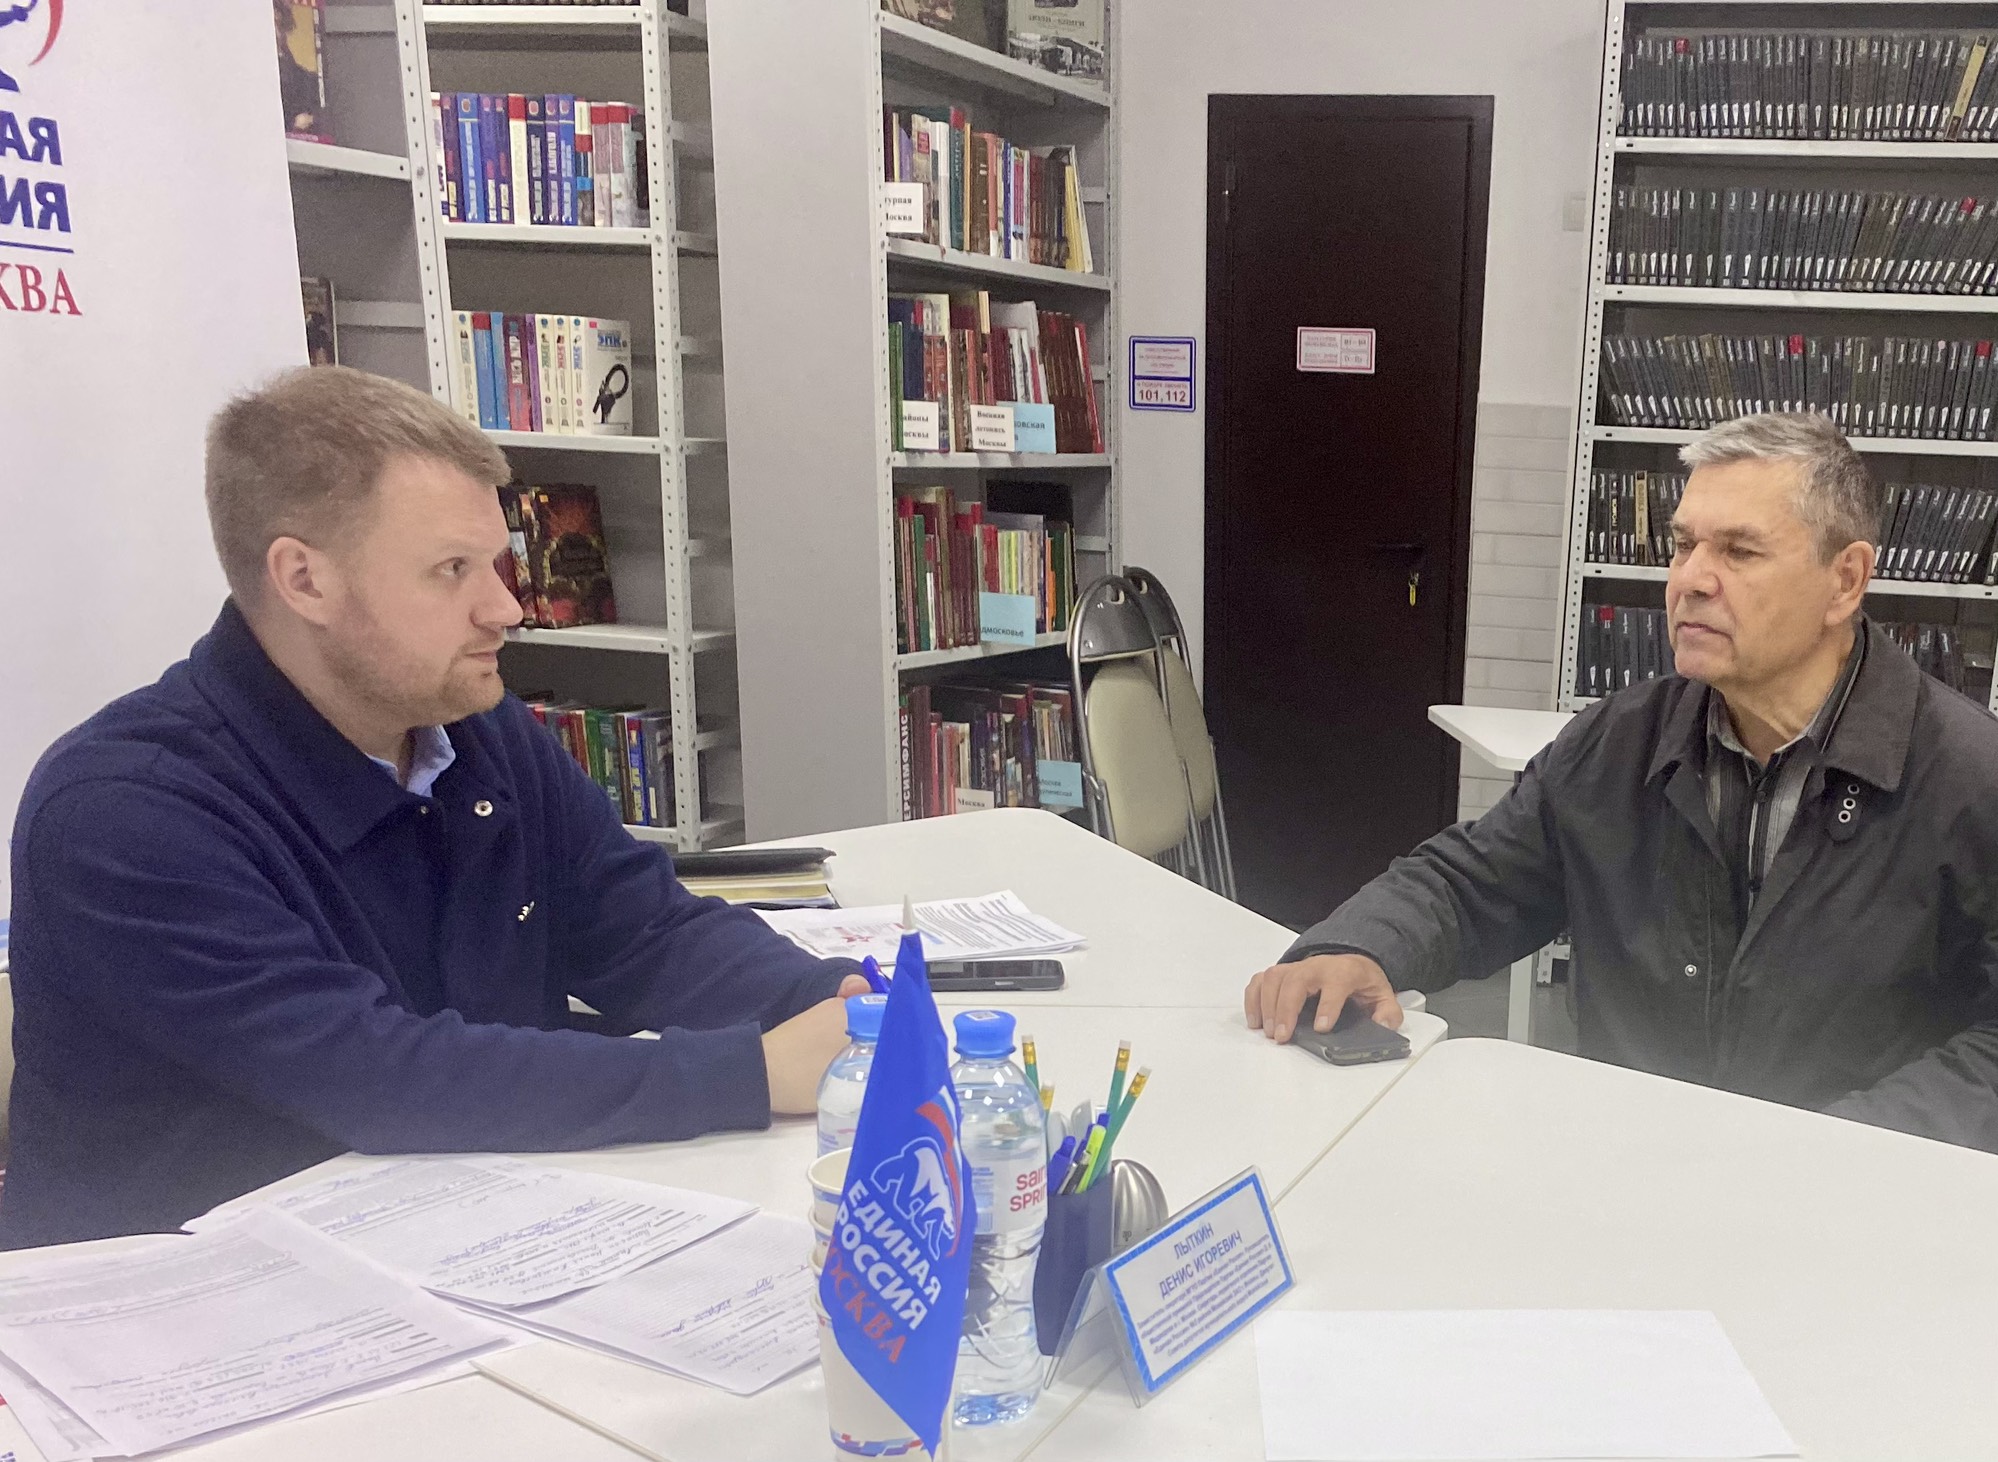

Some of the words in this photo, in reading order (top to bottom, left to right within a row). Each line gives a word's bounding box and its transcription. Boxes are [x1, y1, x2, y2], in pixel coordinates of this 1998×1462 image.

[0, 110, 63, 166] АЯ
[0, 174, 71, 233] ИЯ
[837, 1200, 928, 1331] РОССИЯ
[848, 1179, 942, 1305] ЕДИНАЯ
[1159, 1263, 1194, 1300] ДЕНИС
[1193, 1229, 1243, 1273] ИГОРЕВИЧ
[1173, 1222, 1214, 1260] ЛЫТКИН
